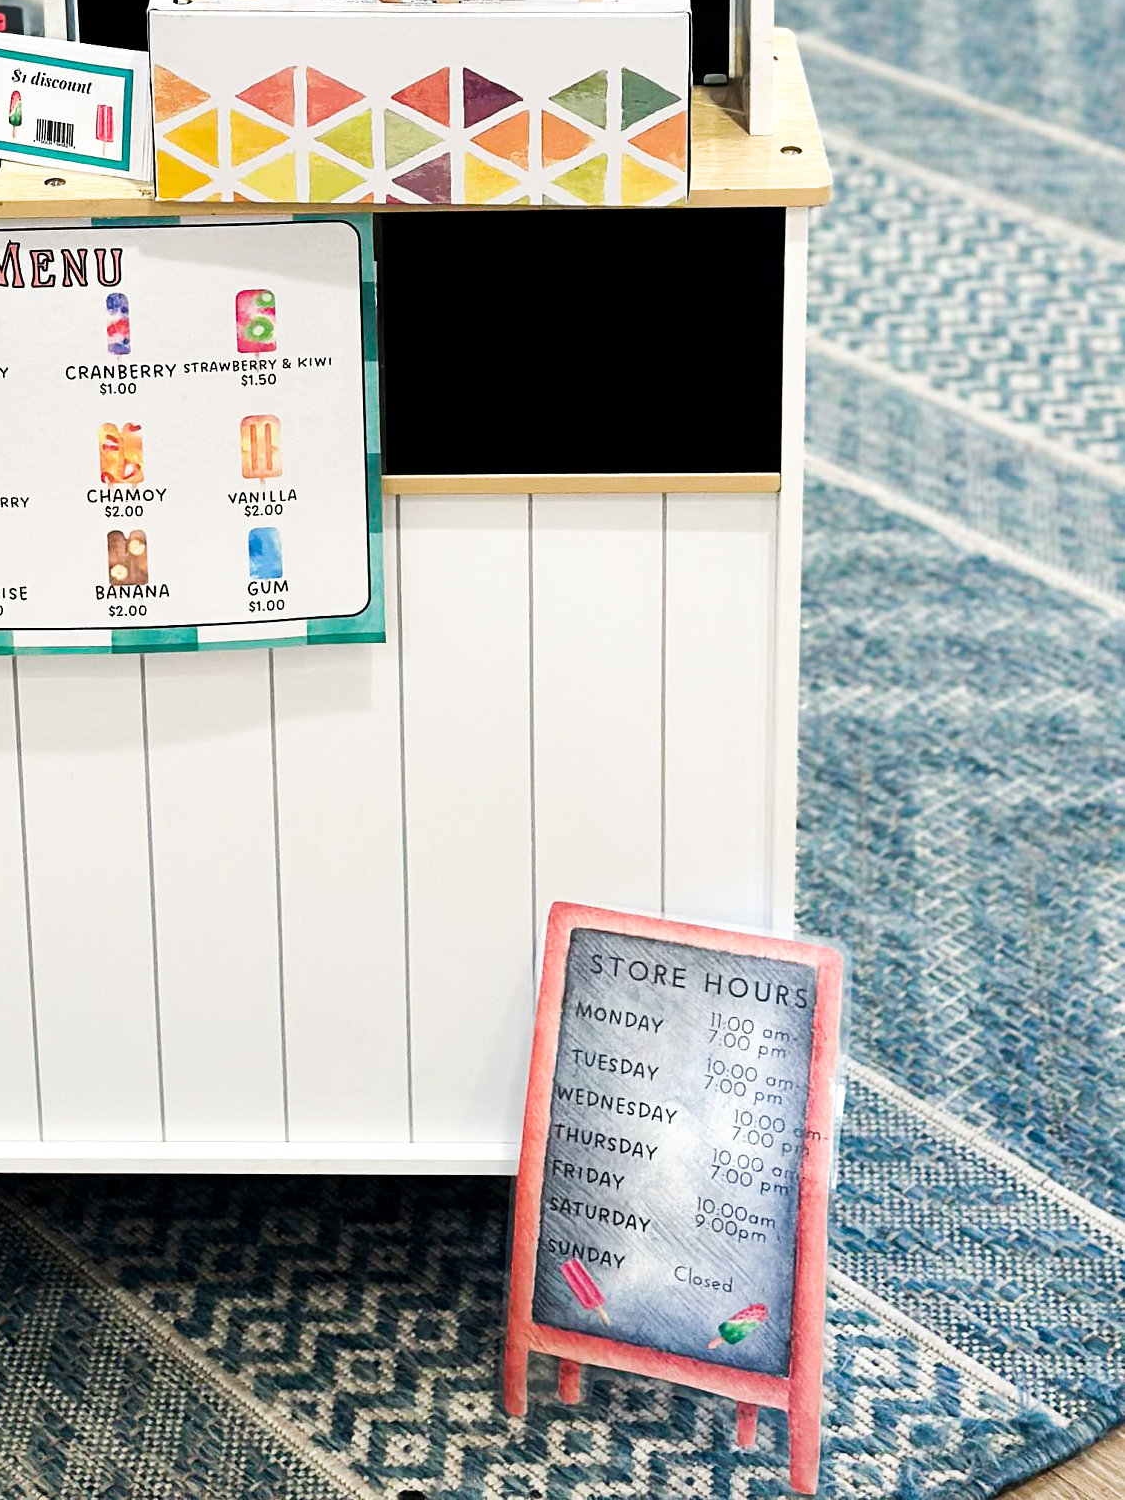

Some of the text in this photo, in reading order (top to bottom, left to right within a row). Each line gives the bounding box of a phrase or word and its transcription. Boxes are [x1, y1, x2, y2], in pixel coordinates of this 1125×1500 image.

[11, 68, 93, 95] $1 discount
[65, 364, 177, 381] CRANBERRY
[183, 357, 333, 375] STRAWBERRY & KIWI
[99, 382, 137, 395] $1.00
[241, 373, 277, 386] $1.50
[86, 488, 167, 503] CHAMOY
[228, 489, 298, 504] VANILLA
[104, 505, 144, 518] $2.00
[244, 504, 283, 517] $2.00
[95, 584, 170, 600] BANANA
[247, 579, 289, 596] GUM
[108, 604, 148, 617] $2.00
[248, 599, 285, 612] $1.00
[590, 954, 808, 1009] STORE HOURS
[575, 1001, 664, 1034] MONDAY
[710, 1012, 754, 1034] 11:00
[708, 1029, 787, 1059] 7:00 pm
[572, 1049, 659, 1082] TUESDAY
[707, 1057, 758, 1082] 10:00
[704, 1075, 783, 1105] 7:00 pm
[557, 1086, 678, 1124] WEDNESDAY
[734, 1109, 785, 1133] 10:00
[732, 1126, 774, 1148] 7:00
[554, 1124, 659, 1161] THURSDAY
[713, 1148, 763, 1173] 10:00
[551, 1160, 625, 1191] FRIDAY
[710, 1165, 789, 1196] 7:00 pm
[549, 1197, 651, 1233] SATURDAY
[548, 1238, 733, 1293] SUNDAY Closed
